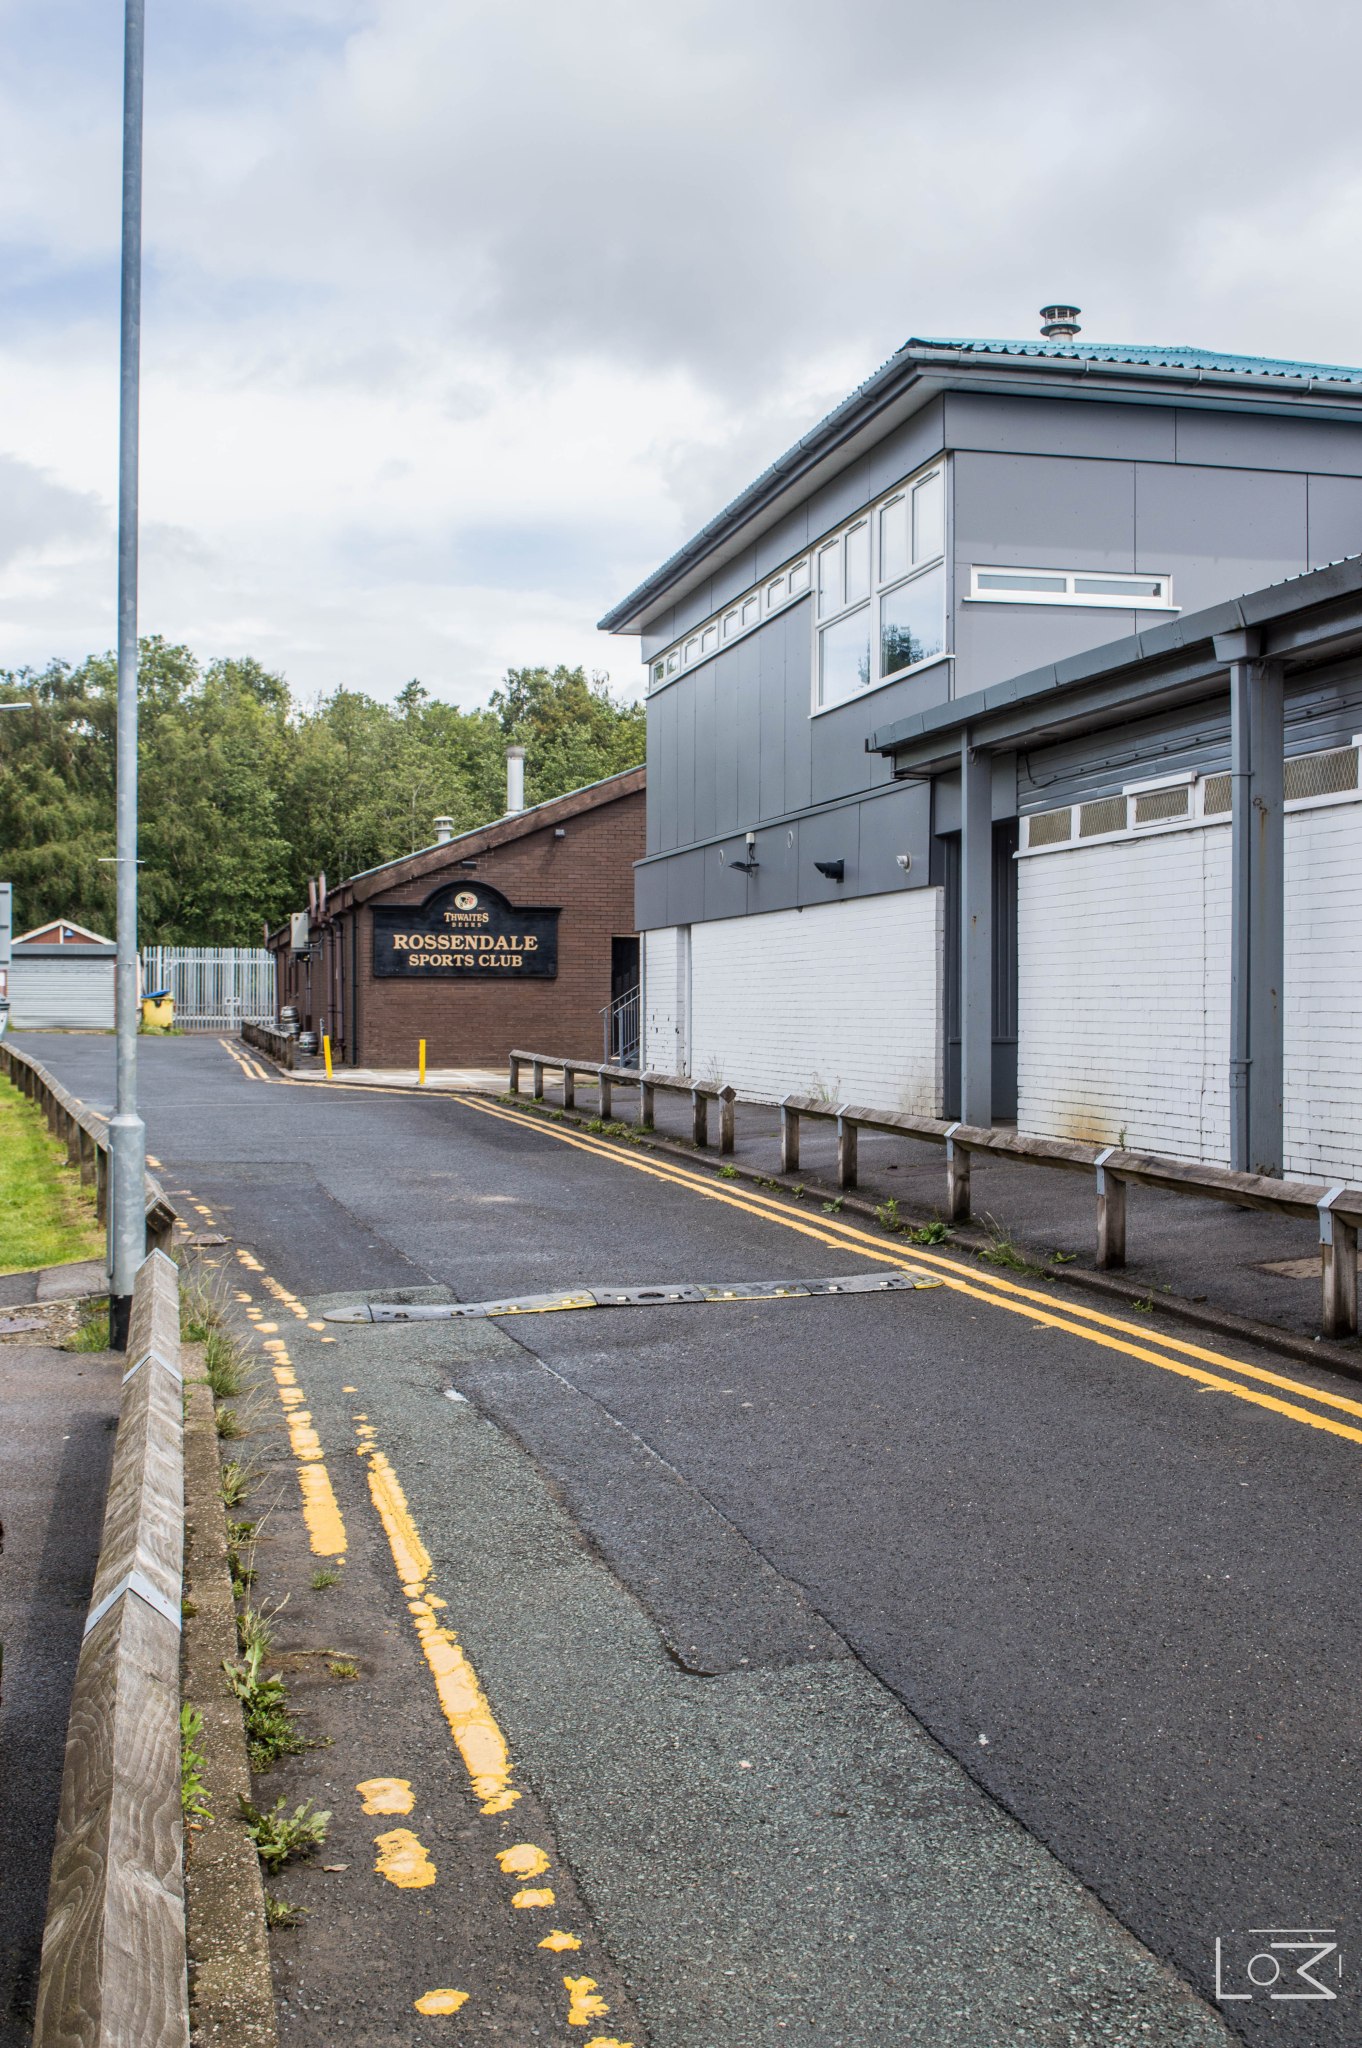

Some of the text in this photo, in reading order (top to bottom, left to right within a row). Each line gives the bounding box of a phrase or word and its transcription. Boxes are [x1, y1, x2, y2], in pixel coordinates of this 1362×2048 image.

[443, 912, 489, 923] THWAITES
[393, 934, 539, 951] ROSSENDALE
[408, 953, 523, 967] SPORTS CLUB
